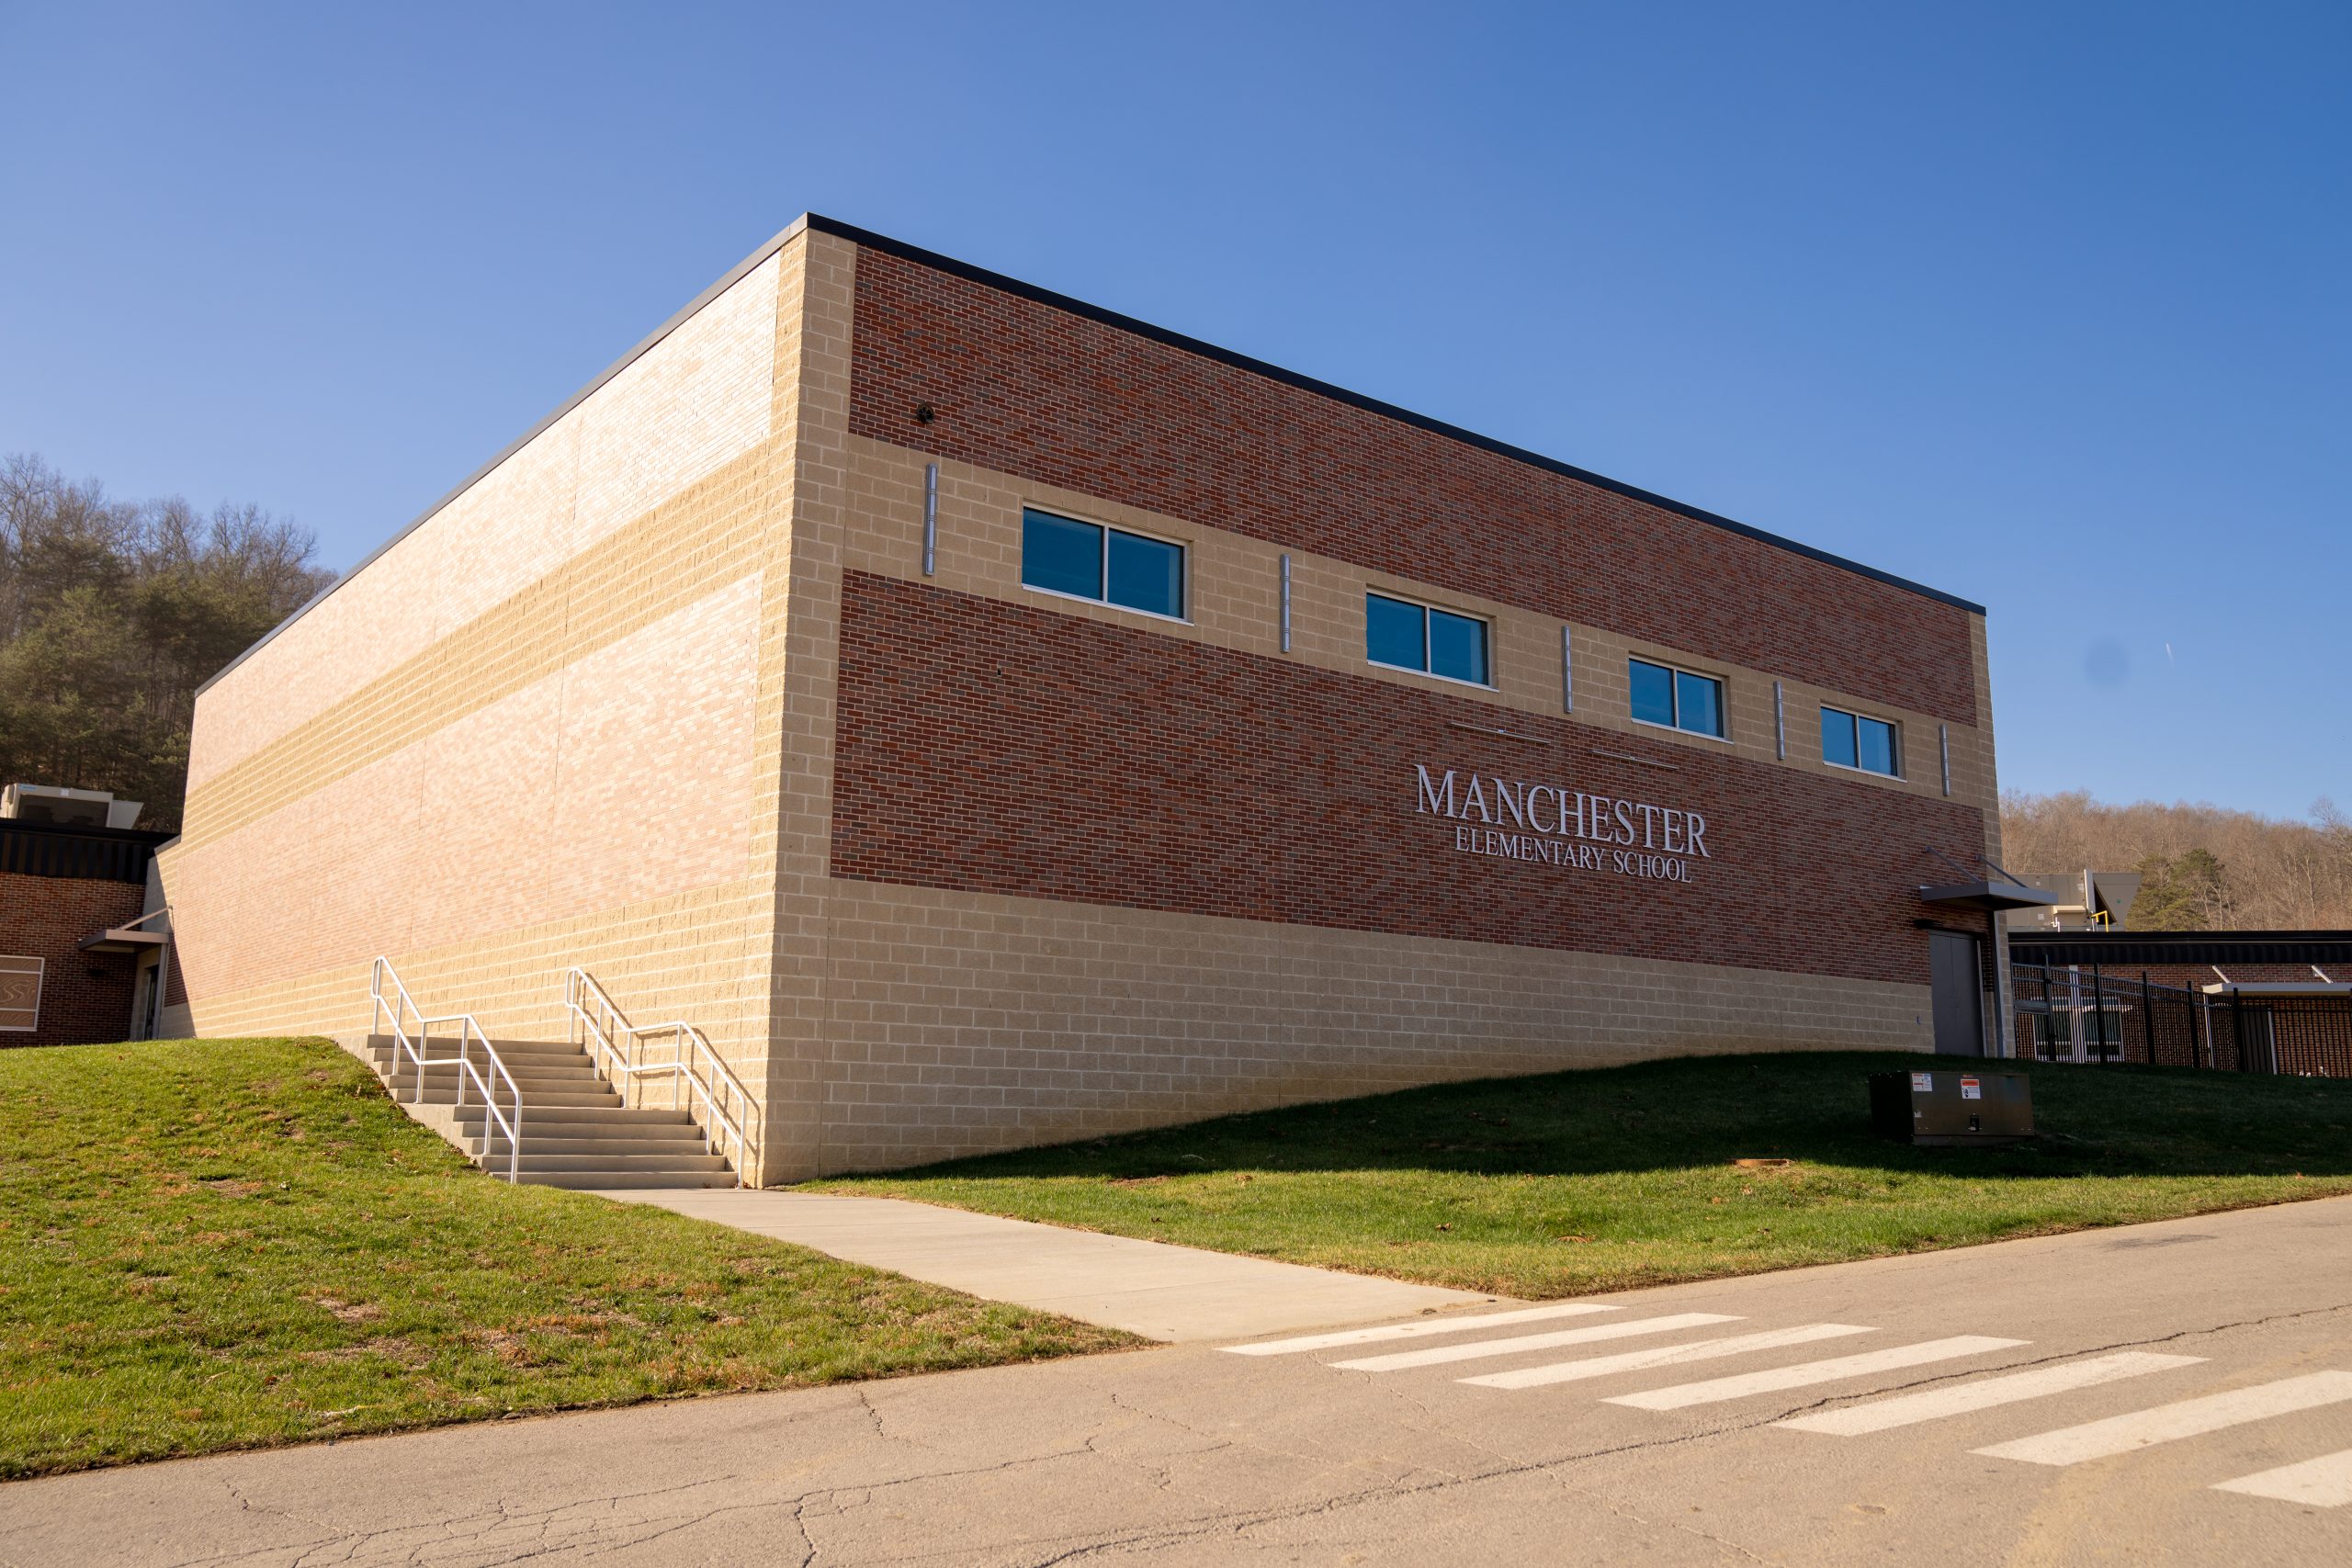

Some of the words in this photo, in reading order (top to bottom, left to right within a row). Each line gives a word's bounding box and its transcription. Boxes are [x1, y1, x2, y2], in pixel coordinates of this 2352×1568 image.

[1413, 764, 1711, 858] MANCHESTER
[1455, 826, 1605, 872] ELEMENTARY
[1612, 849, 1692, 884] SCHOOL
